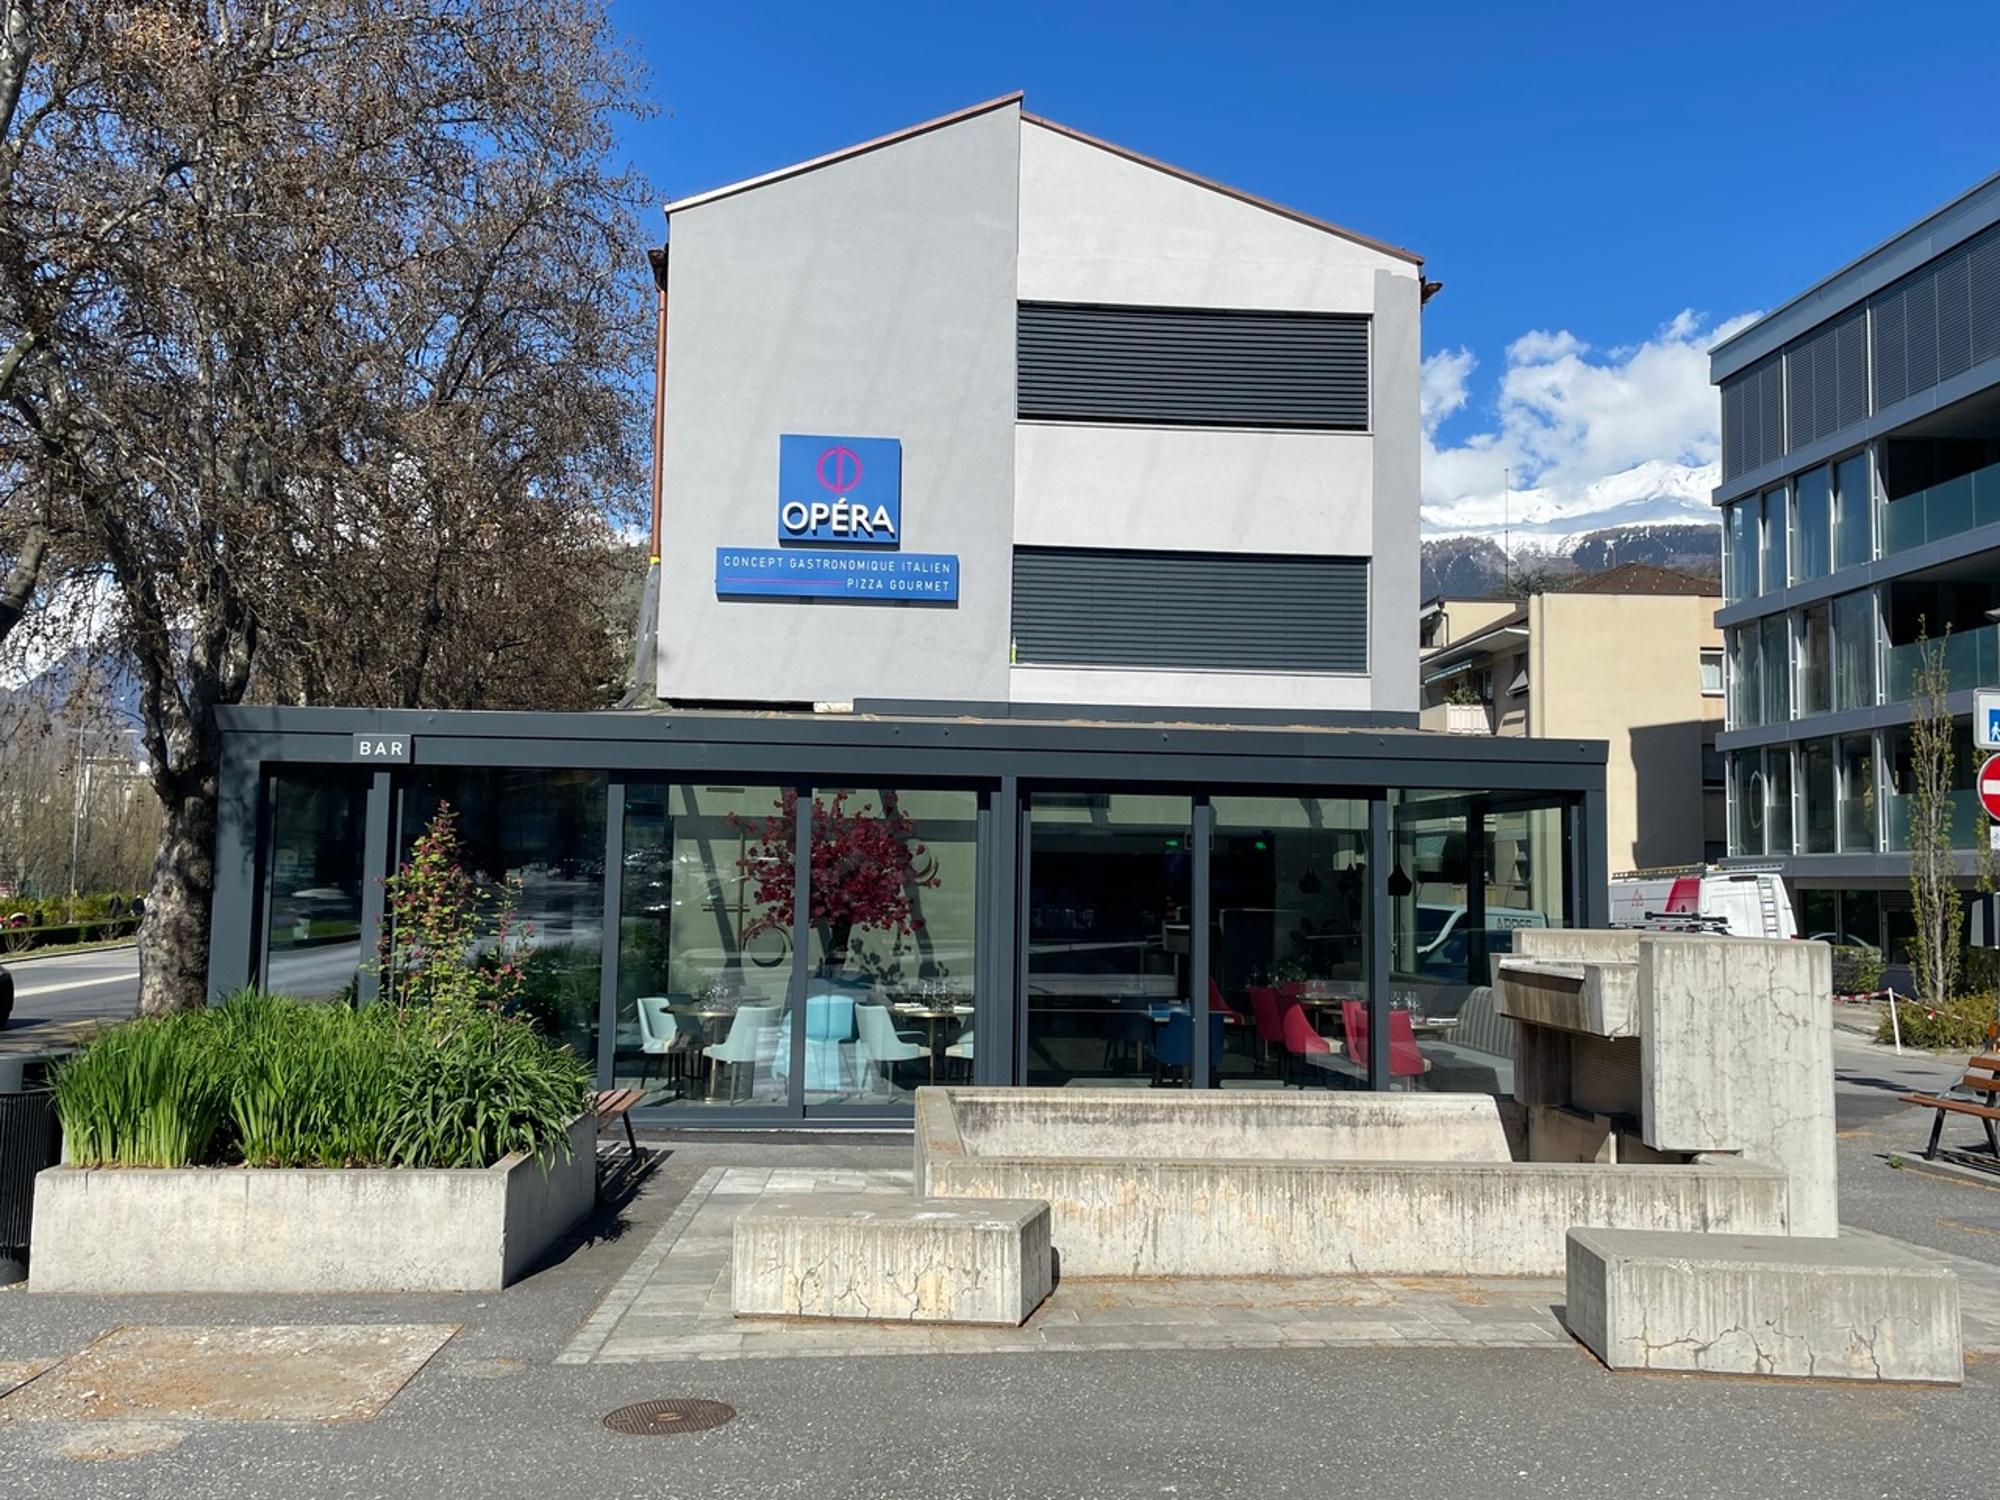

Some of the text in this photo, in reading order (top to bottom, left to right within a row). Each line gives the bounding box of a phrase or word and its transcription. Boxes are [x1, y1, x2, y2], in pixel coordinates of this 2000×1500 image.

[782, 497, 895, 533] OPÉRA
[723, 555, 950, 574] CONCEPT GASTRONOMIQUE ITALIEN
[847, 577, 949, 592] PIZZA GOURMET
[359, 741, 403, 756] BAR
